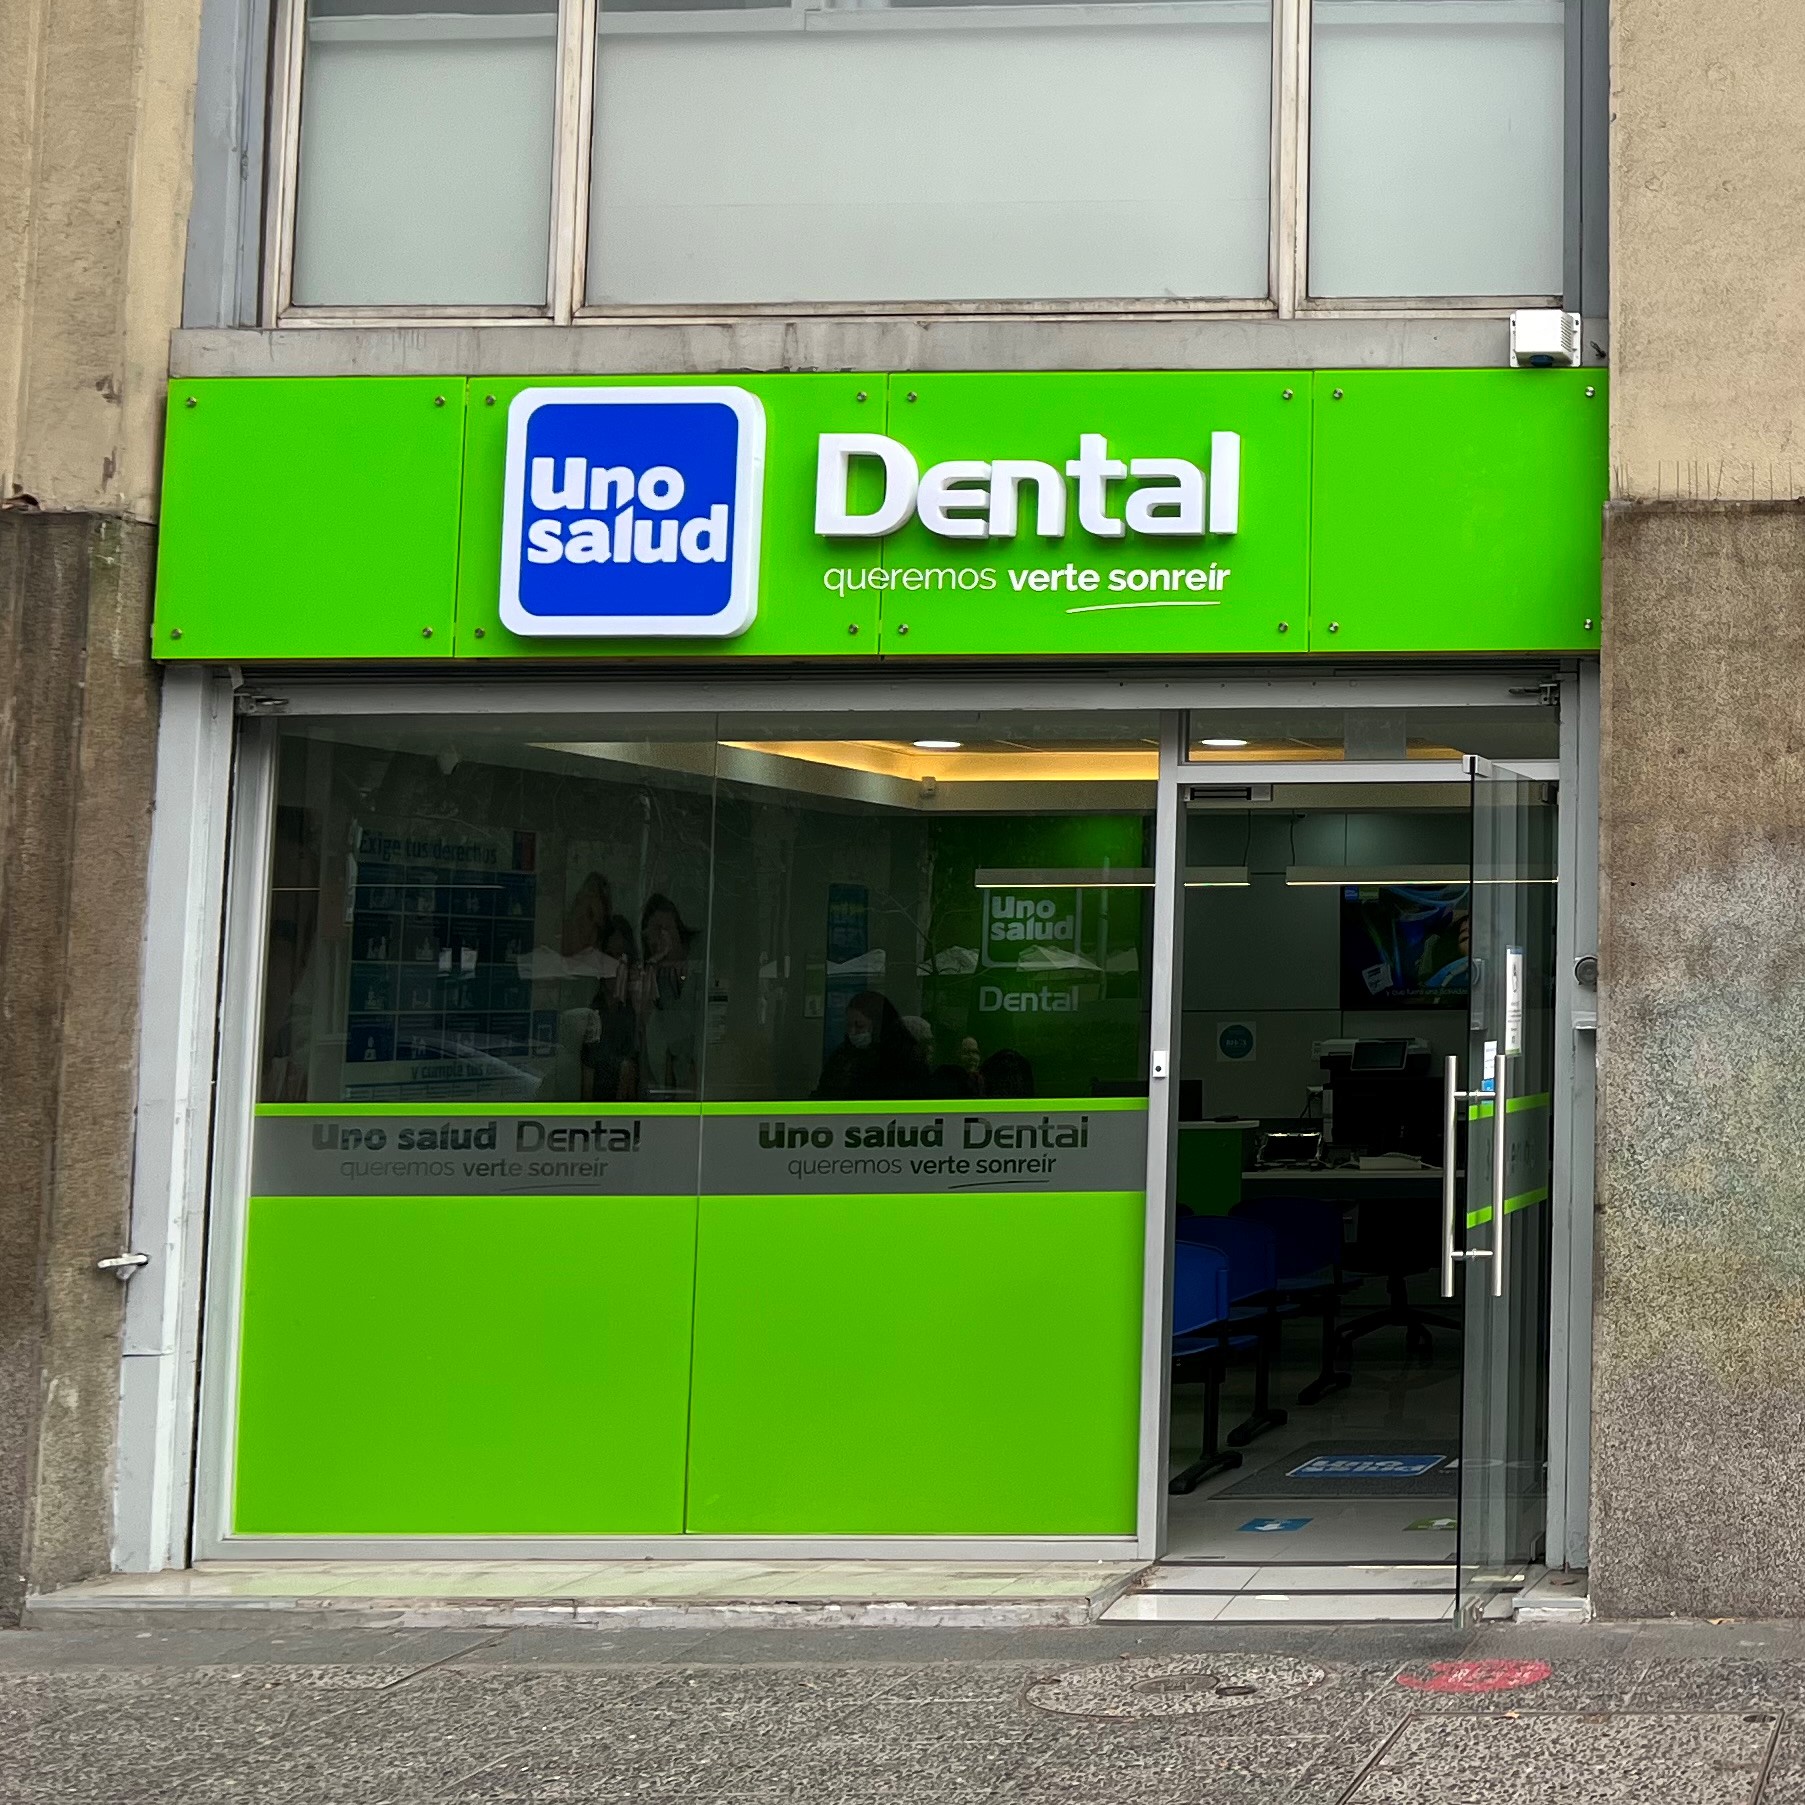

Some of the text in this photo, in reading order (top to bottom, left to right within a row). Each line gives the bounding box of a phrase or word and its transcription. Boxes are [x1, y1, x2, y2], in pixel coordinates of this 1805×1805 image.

[814, 431, 1241, 539] Dental
[527, 503, 729, 564] salud
[823, 562, 1231, 597] queremos verte sonreír
[990, 915, 1075, 941] salud
[979, 985, 1080, 1012] Dental
[398, 1121, 497, 1151] salud
[516, 1120, 642, 1152] Dental
[844, 1118, 943, 1149] salud
[963, 1116, 1089, 1149] Dental
[340, 1158, 456, 1180] queremos
[463, 1157, 523, 1177] verte
[788, 1152, 1057, 1179] queremos verte sonreír
